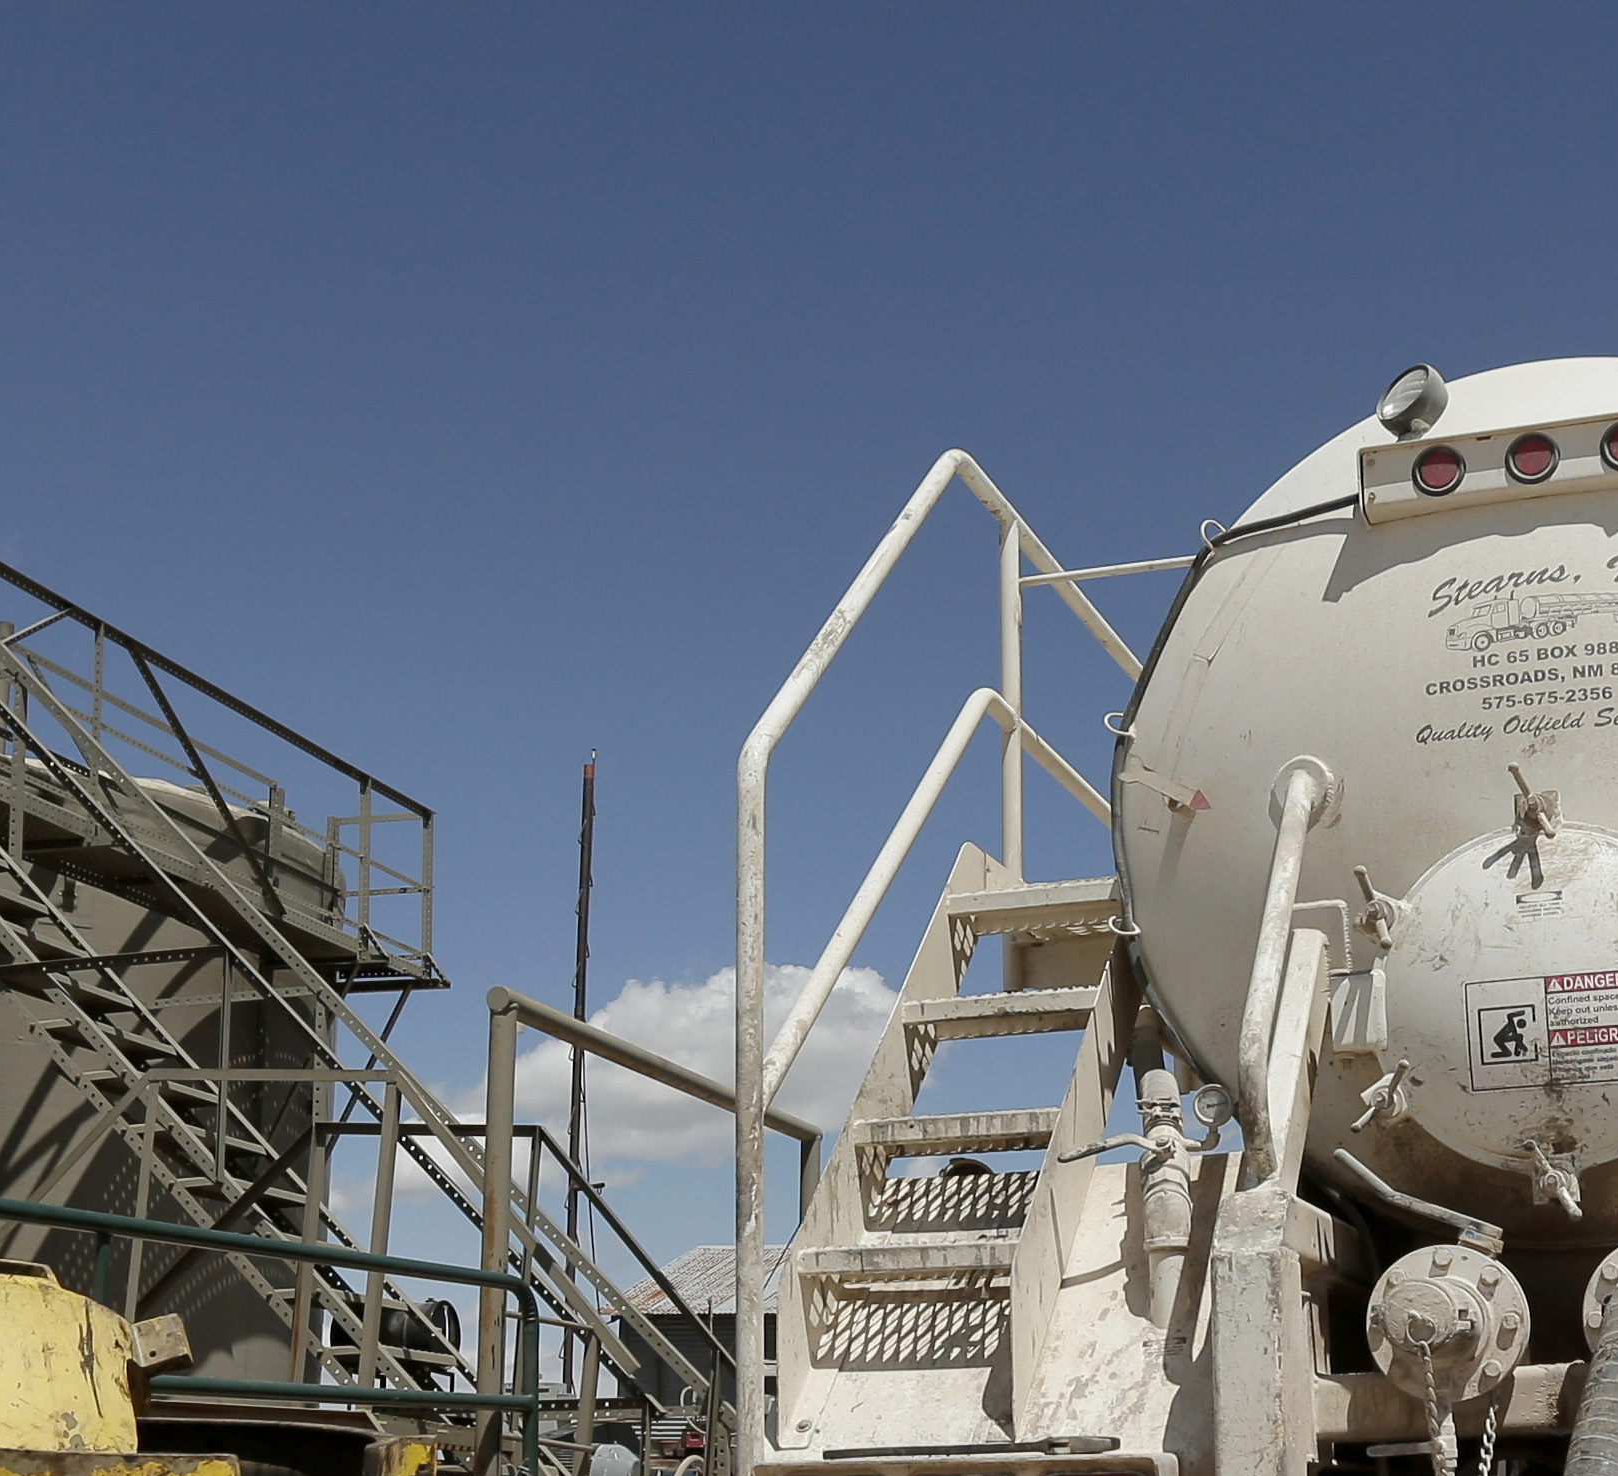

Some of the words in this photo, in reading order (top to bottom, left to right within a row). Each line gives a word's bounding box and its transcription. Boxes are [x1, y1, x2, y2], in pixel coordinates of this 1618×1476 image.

[1428, 563, 1581, 618] Stearns,
[1472, 653, 1500, 669] HC
[1506, 650, 1530, 664] 65
[1536, 644, 1578, 661] BOX
[1425, 667, 1566, 696] CROSSROADS,
[1572, 664, 1604, 680] NM
[1481, 686, 1614, 711] 575-675-2356
[1416, 722, 1495, 745] Quality
[1502, 711, 1586, 738] Oilfield
[1548, 994, 1590, 1005] Confined
[1549, 1006, 1573, 1016] Keep
[1575, 1005, 1591, 1014] out
[1550, 1015, 1599, 1027] authorized
